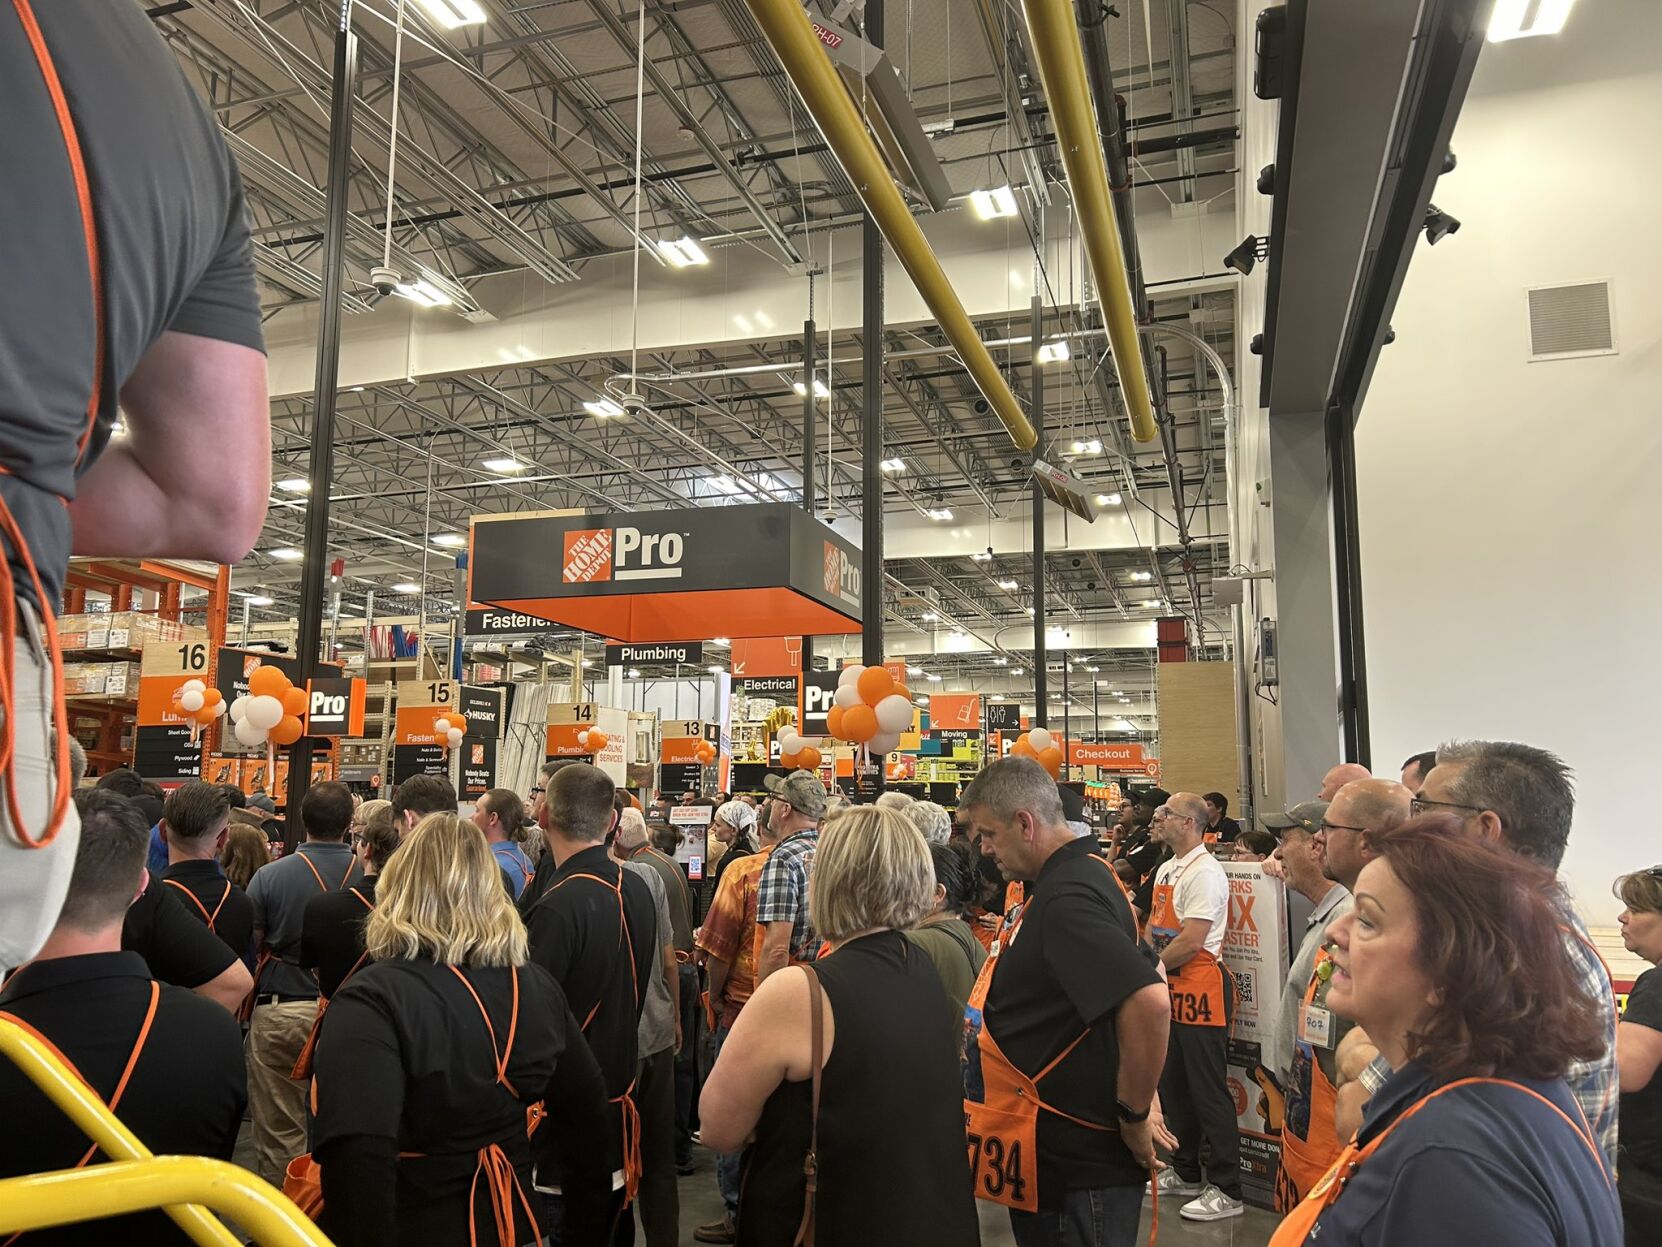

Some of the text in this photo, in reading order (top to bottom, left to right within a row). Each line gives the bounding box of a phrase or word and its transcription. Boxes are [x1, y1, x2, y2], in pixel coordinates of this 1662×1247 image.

[568, 535, 589, 557] THE
[562, 529, 613, 583] HOME
[582, 548, 612, 582] DEPOT
[840, 550, 861, 596] Pro
[482, 612, 560, 629] Fastene
[178, 644, 206, 670] 16
[621, 647, 687, 661] Plumbing
[744, 679, 796, 691] Electrical
[428, 683, 450, 703] 15
[805, 686, 837, 711] Pr
[310, 691, 345, 715] Pro
[472, 710, 496, 722] HUSKY
[573, 705, 592, 721] 14
[684, 722, 700, 735] 13
[941, 730, 968, 739] Moving
[407, 734, 435, 743] Fasten
[599, 754, 624, 763] SERVICES
[891, 753, 898, 762] 9
[1075, 749, 1131, 760] Checkout
[1223, 931, 1259, 948] ASTER
[1243, 1020, 1256, 1028] NOW
[1240, 1136, 1250, 1145] GET
[1250, 1139, 1267, 1150] MORE
